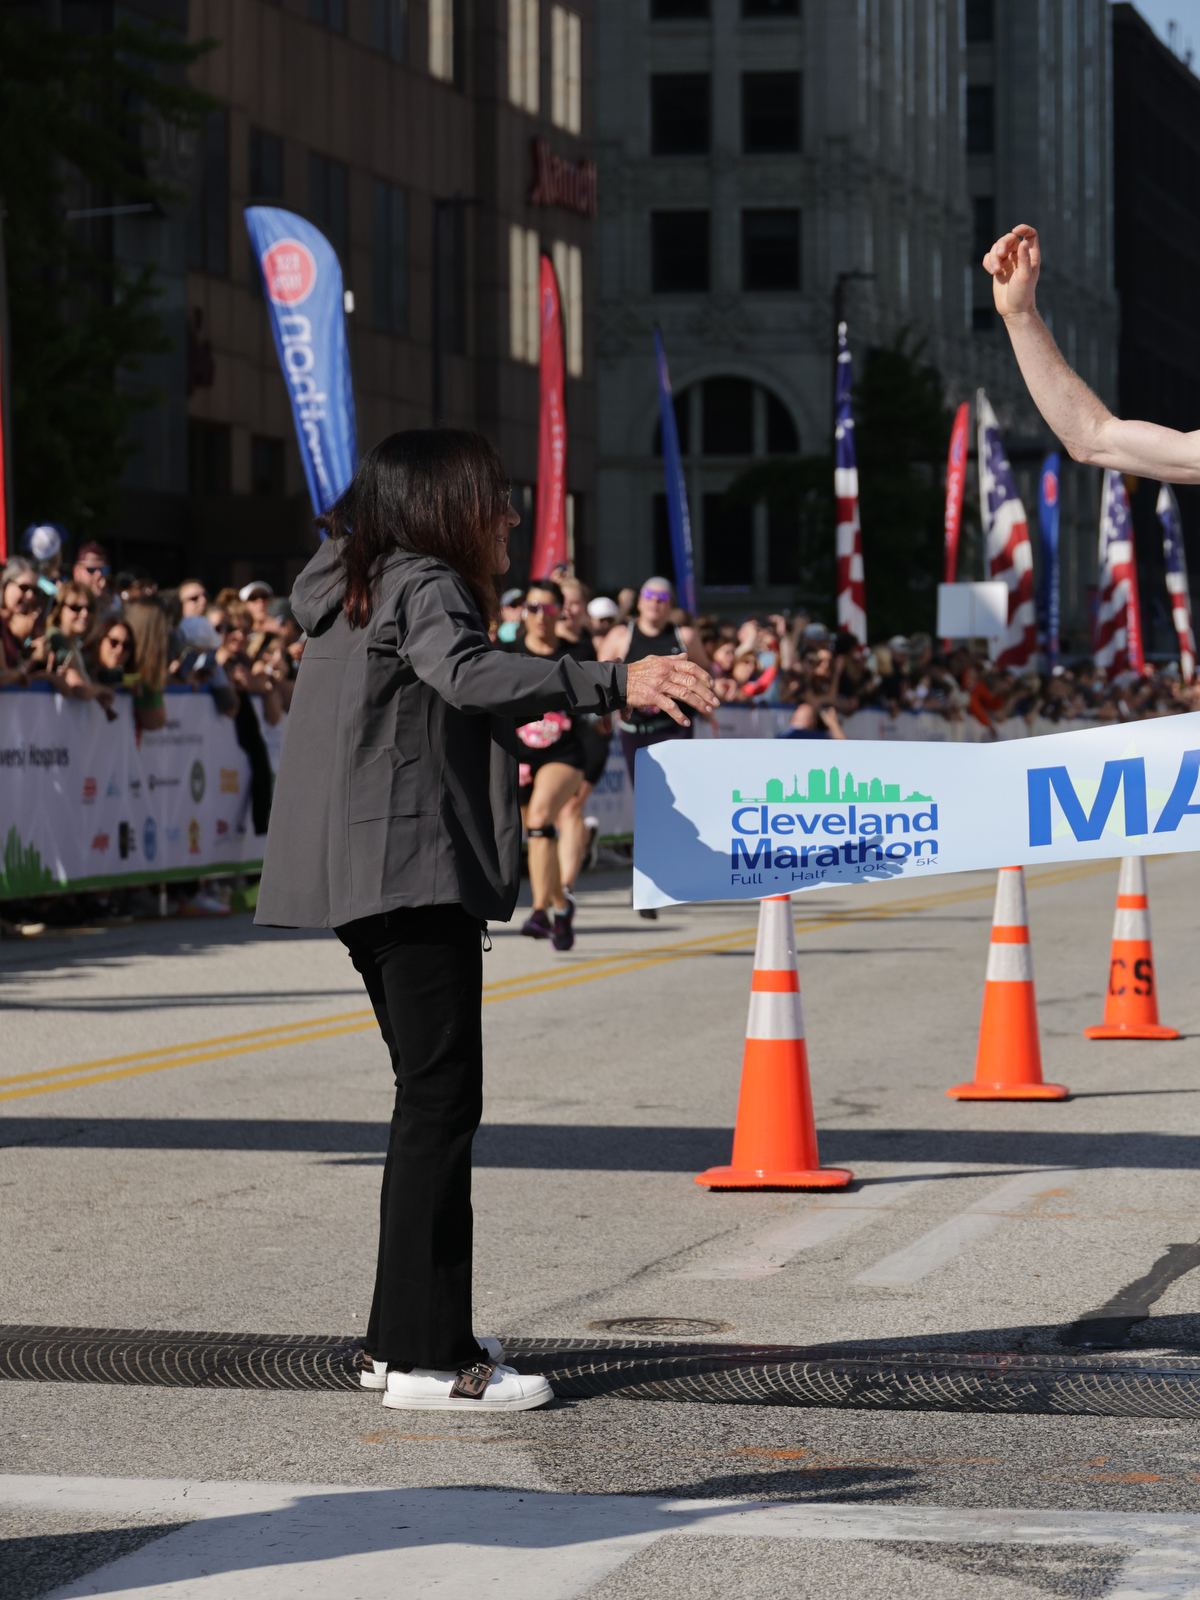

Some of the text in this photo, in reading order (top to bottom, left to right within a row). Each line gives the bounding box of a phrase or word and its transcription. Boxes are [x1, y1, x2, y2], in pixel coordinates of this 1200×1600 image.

[731, 803, 939, 835] Cleveland
[731, 836, 939, 870] Marathon
[731, 857, 938, 885] Full Half 10K 5K
[1110, 959, 1153, 996] CS
